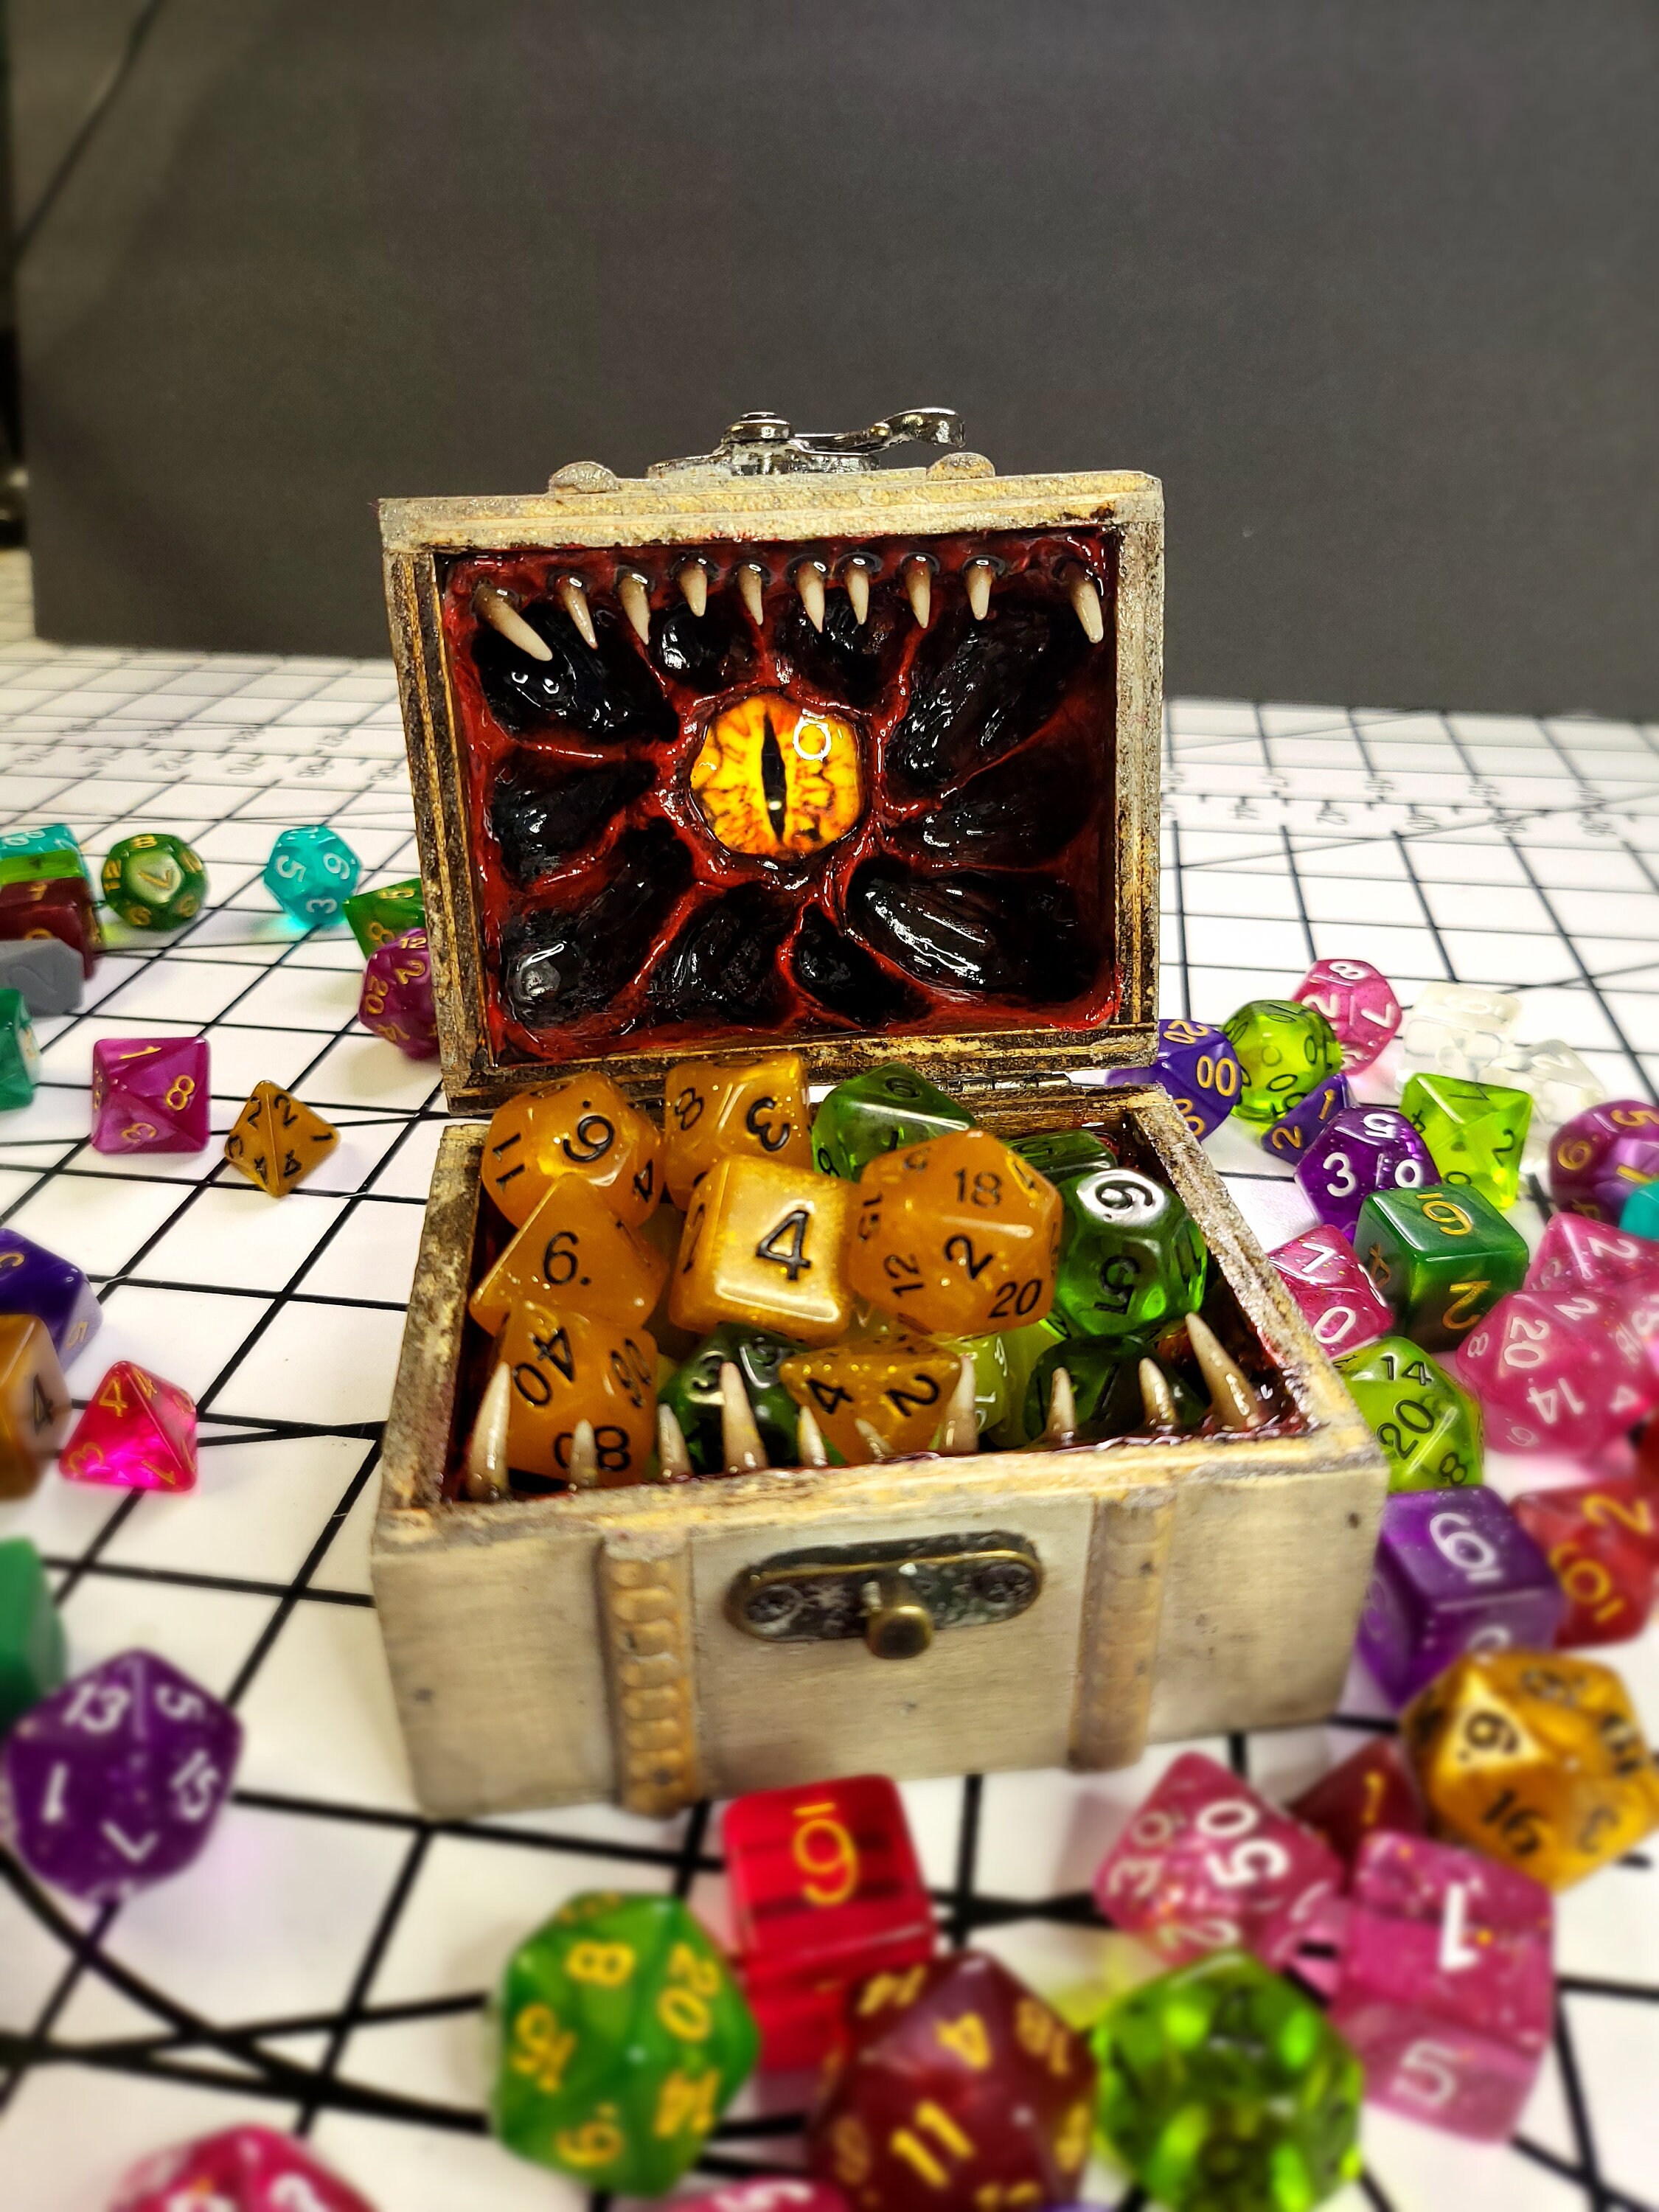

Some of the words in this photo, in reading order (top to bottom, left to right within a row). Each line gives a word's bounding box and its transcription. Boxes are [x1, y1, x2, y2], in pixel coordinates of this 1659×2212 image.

[276, 855, 307, 883] 5
[305, 898, 338, 914] 3
[400, 937, 427, 949] 12
[394, 959, 425, 985] 2
[1328, 961, 1367, 980] 8
[164, 1074, 196, 1111] 8
[1196, 1054, 1238, 1097] 00
[274, 1093, 299, 1128] 2
[674, 1087, 704, 1131] 8
[745, 1096, 790, 1152] 3
[1318, 1088, 1335, 1121] 1
[1271, 1124, 1302, 1150] 2
[1363, 1113, 1399, 1139] 5
[954, 1167, 1003, 1209] 18
[1322, 1152, 1357, 1197] 3
[755, 1209, 811, 1281] 4
[944, 1233, 994, 1281] 2
[1587, 1236, 1641, 1260] 2
[883, 1252, 925, 1299] 12
[987, 1278, 1043, 1320] 20
[1441, 1279, 1492, 1330] 2
[1553, 1296, 1599, 1321] 2
[1311, 1305, 1357, 1344] 0
[1466, 1330, 1490, 1359] 8
[1503, 1315, 1549, 1368] 20
[512, 1326, 576, 1407] 40
[1380, 1354, 1433, 1387] 14
[99, 1377, 129, 1418] 4
[807, 1377, 853, 1416] 4
[886, 1373, 940, 1418] 2
[1526, 1377, 1587, 1425] 14
[1375, 1399, 1435, 1461] 20
[1439, 1451, 1469, 1488] 8
[1582, 1494, 1652, 1534] 2
[63, 1683, 131, 1734] 13
[1438, 1882, 1481, 1972] 1
[655, 1941, 721, 2042] 20
[891, 2098, 975, 2188] 11
